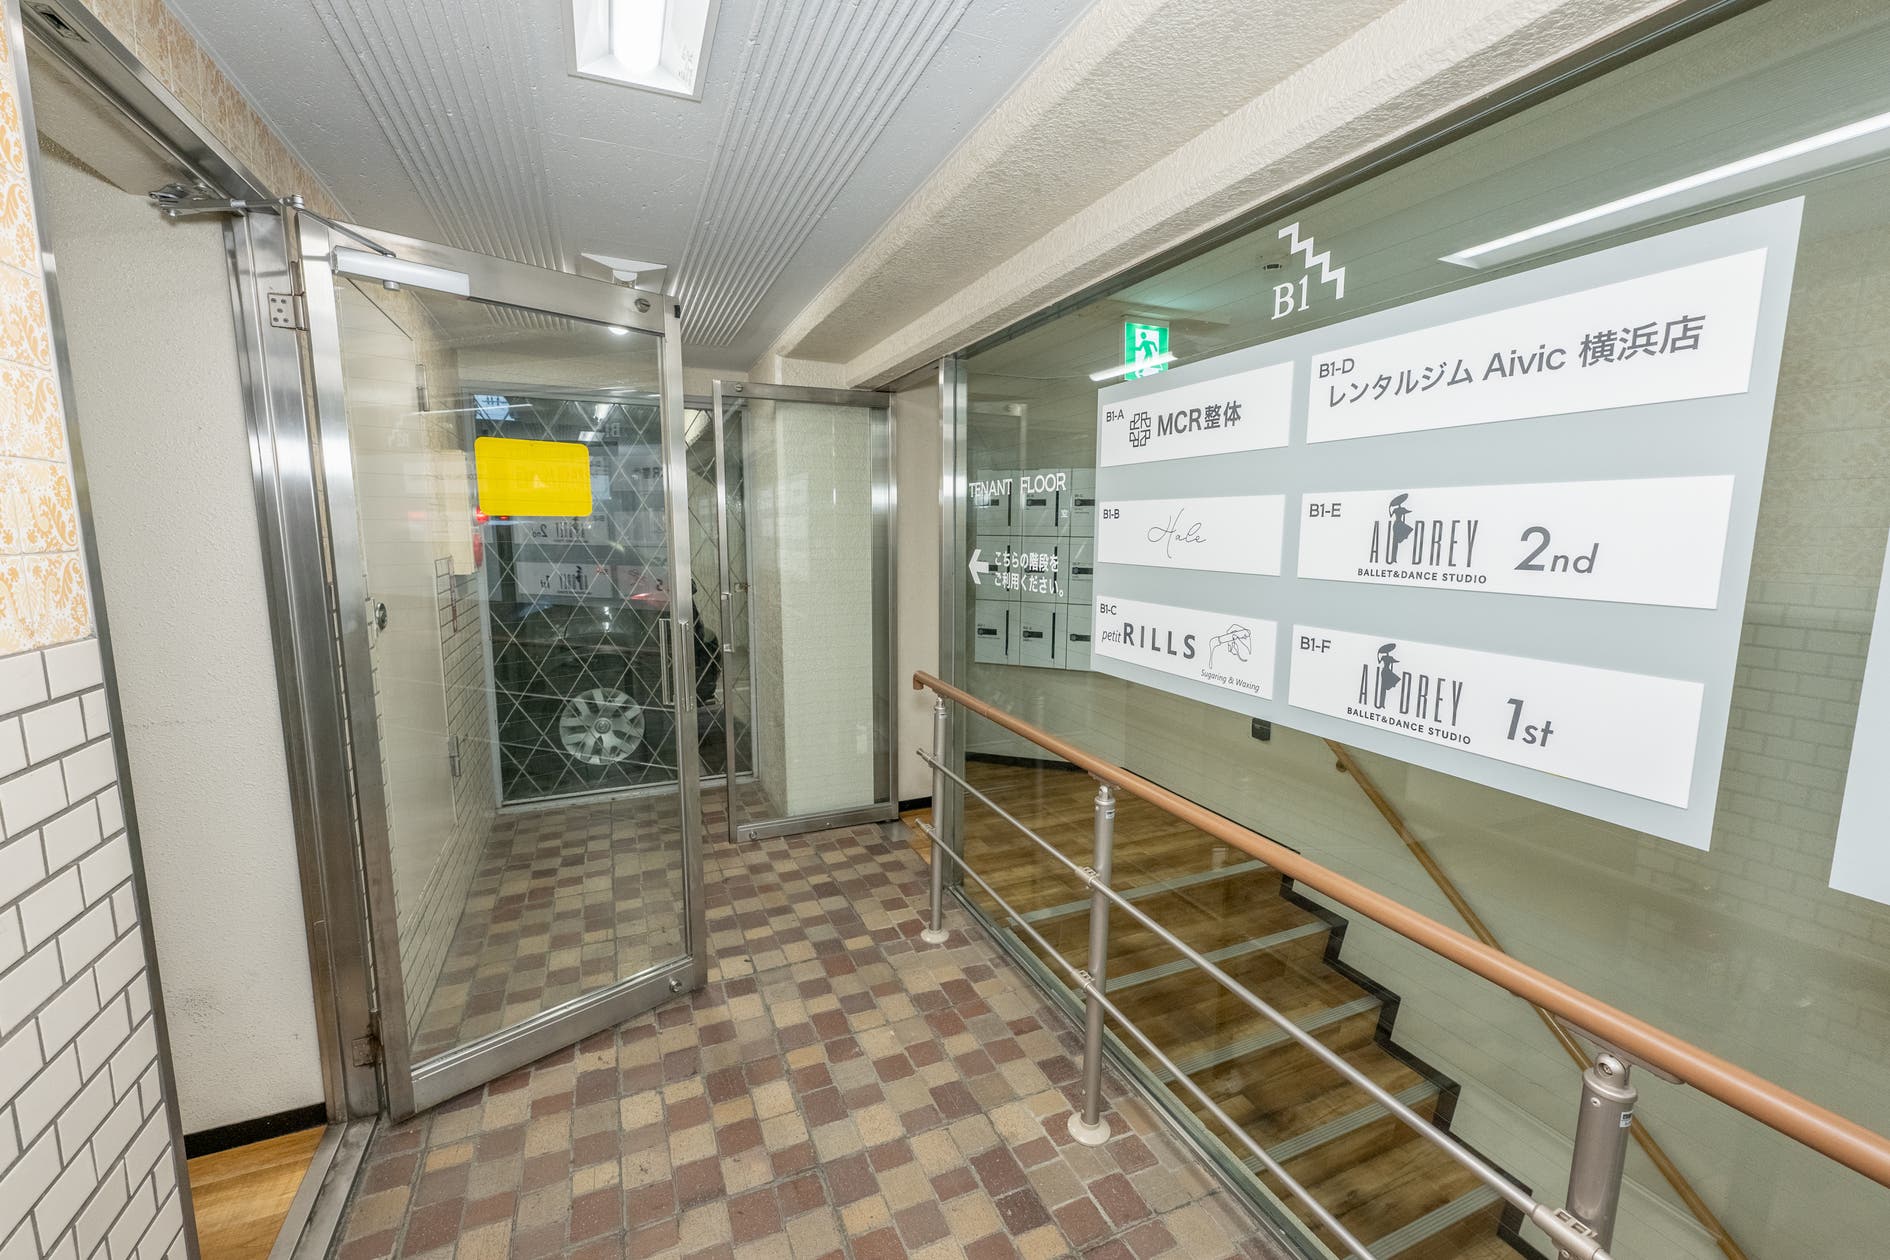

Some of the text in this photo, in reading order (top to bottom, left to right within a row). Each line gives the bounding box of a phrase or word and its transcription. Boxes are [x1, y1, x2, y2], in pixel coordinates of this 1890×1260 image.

[1271, 275, 1310, 320] B1
[1319, 358, 1355, 378] B1-D
[1329, 314, 1706, 408] レンタルジム Aivic 横浜店
[1106, 409, 1125, 422] B1-A
[1157, 400, 1242, 437] MCR整体
[968, 472, 1067, 498] TENANT FLOOR
[1103, 508, 1120, 519] B1-B
[1309, 503, 1341, 518] B1-E
[1369, 520, 1600, 574] AUDREY 2nd
[994, 551, 1059, 573] こちらの階段を
[994, 572, 1064, 598] ご利用ください。
[1357, 568, 1487, 584] BALLET&DANCE STUDIO
[1100, 603, 1117, 616] B1-C
[1101, 622, 1196, 660] petit RILLS
[1300, 636, 1332, 653] B1-F
[1200, 668, 1260, 693] Sugaring & Waxing
[1359, 664, 1555, 747] AUDREY 1st
[1347, 706, 1471, 745] BALLET&DANCE STUDIO
